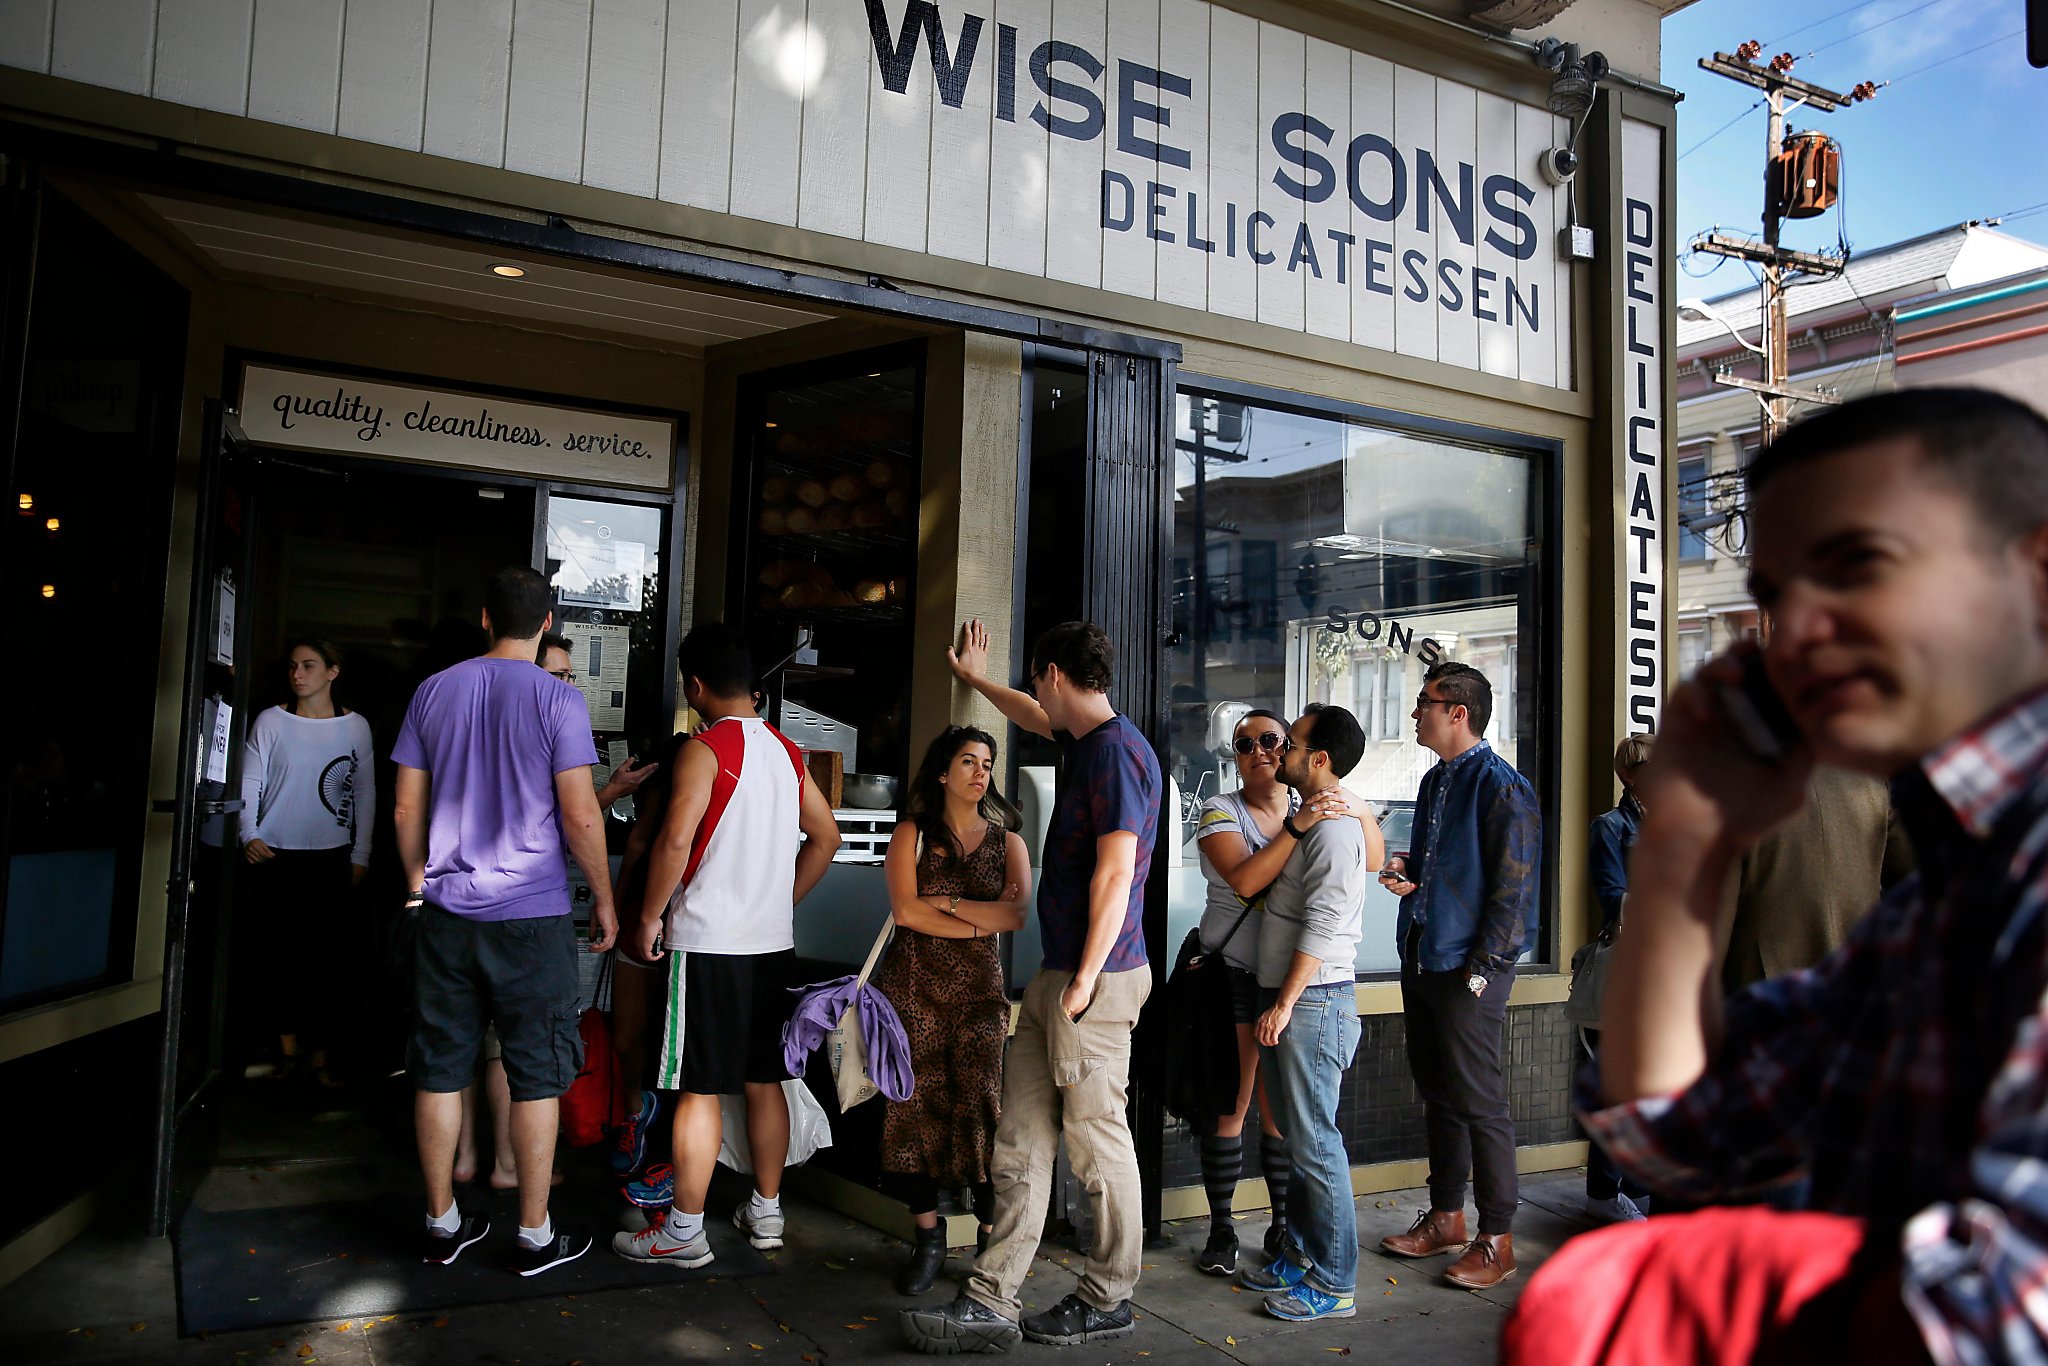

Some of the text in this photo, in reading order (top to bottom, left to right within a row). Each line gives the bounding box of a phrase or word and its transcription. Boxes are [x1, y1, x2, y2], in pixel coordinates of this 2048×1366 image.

[864, 0, 1538, 261] WISE SONS
[1102, 168, 1539, 333] DELICATESSEN
[272, 387, 653, 461] quality. cleanliness. service.
[1325, 604, 1442, 668] SONS
